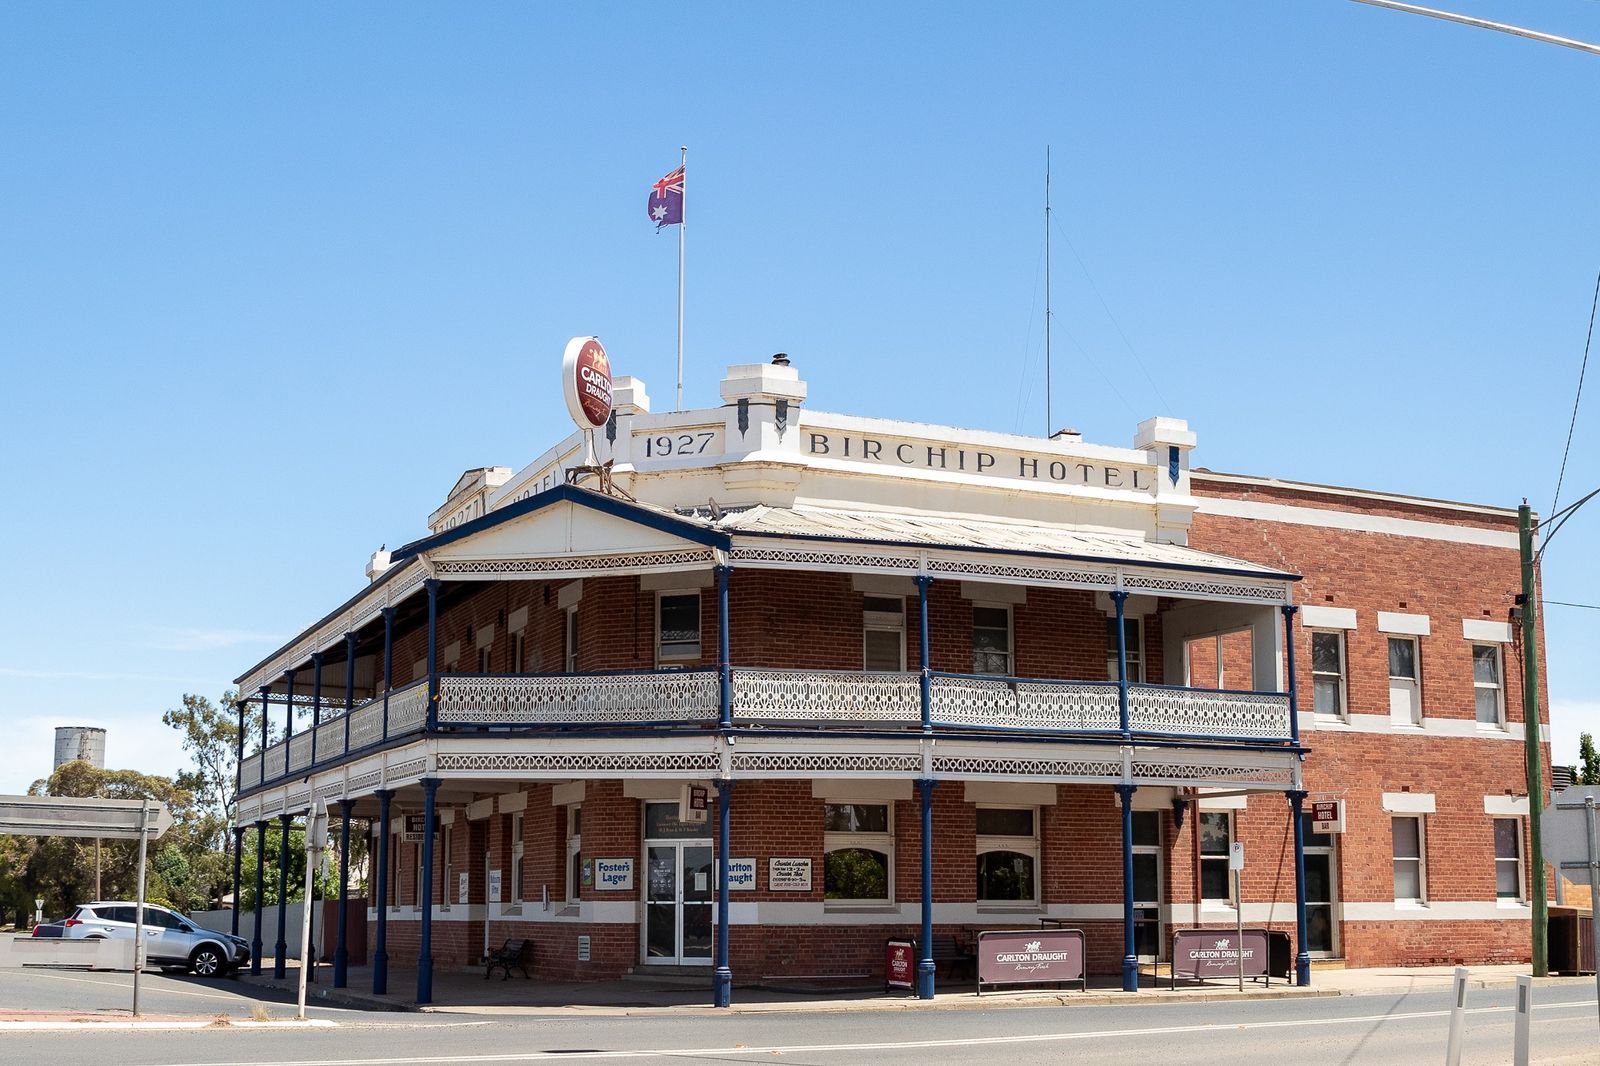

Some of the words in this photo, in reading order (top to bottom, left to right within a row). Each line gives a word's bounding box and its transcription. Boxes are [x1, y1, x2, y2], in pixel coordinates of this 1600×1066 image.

[581, 367, 612, 394] CARLTO
[646, 432, 714, 458] 1927
[810, 433, 995, 472] BIRCHIP
[1019, 457, 1150, 491] HOTEL
[1317, 811, 1333, 820] HOTEL
[413, 823, 425, 832] HOT
[598, 862, 630, 872] Foster's
[728, 863, 752, 871] arlton
[602, 873, 627, 885] Lager
[728, 873, 753, 884] aught
[996, 953, 1031, 962] CARLTON
[1032, 952, 1068, 961] DRAUGHT
[1189, 950, 1220, 959] CARLTON
